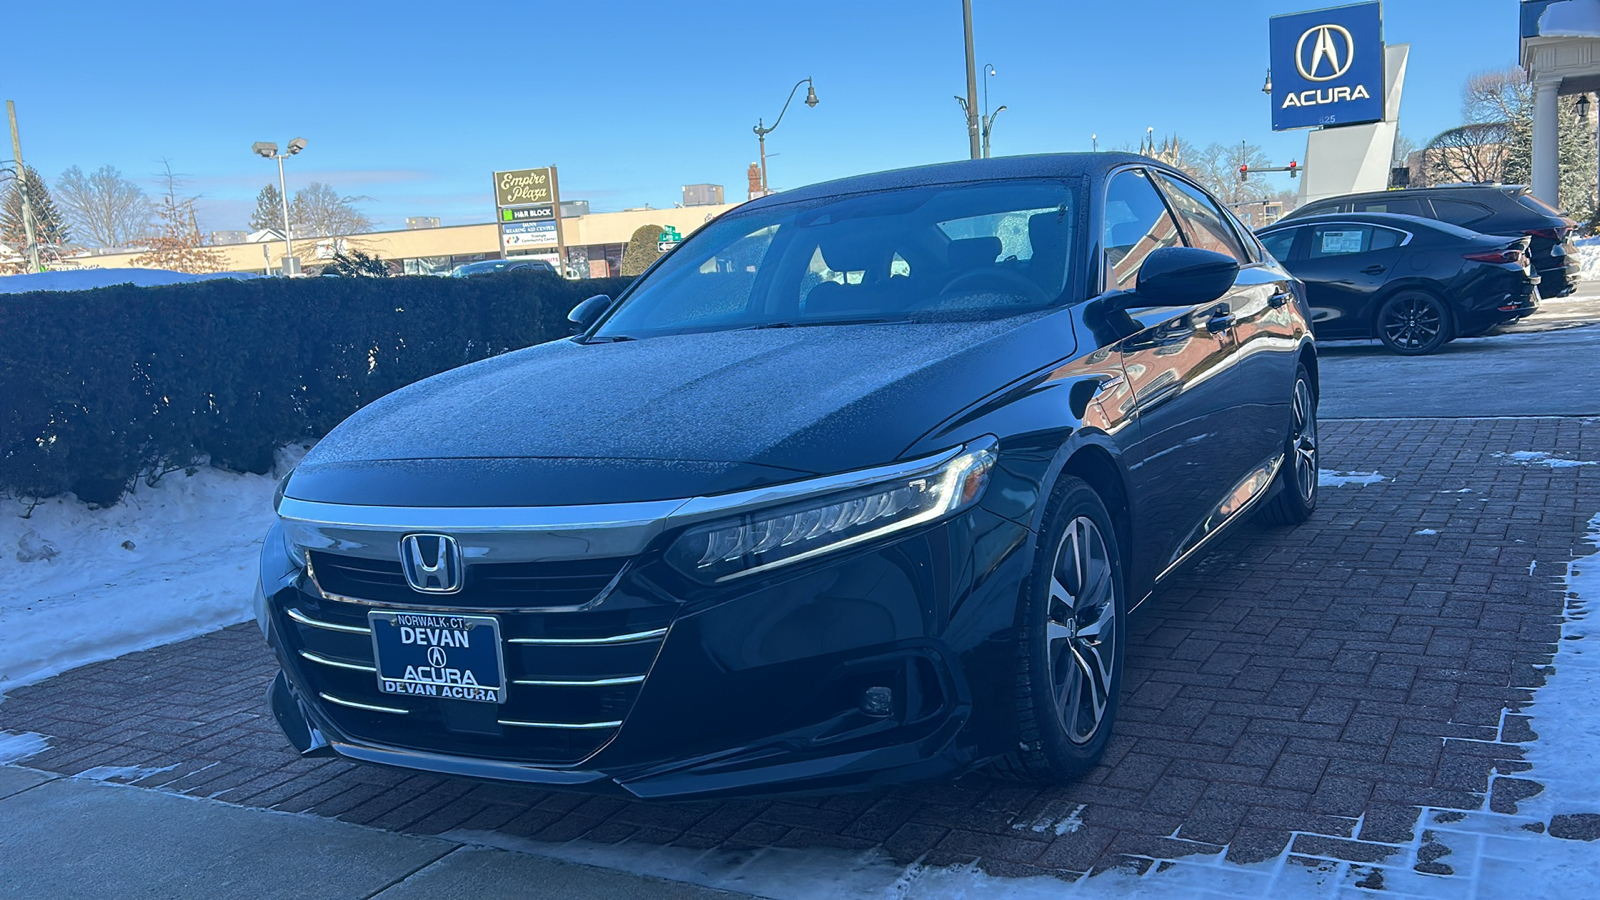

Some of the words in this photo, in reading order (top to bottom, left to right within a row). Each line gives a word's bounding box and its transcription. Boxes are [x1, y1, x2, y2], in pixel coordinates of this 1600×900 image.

[1282, 84, 1370, 109] ACURA
[501, 173, 546, 190] Empire
[507, 186, 547, 202] Plaza
[514, 210, 529, 218] H&R
[530, 209, 551, 217] BLOCK
[450, 617, 463, 628] CT
[400, 626, 470, 648] DEVAN
[403, 665, 478, 686] ACURA
[385, 681, 437, 696] DEVAN
[441, 686, 497, 702] ACURA
